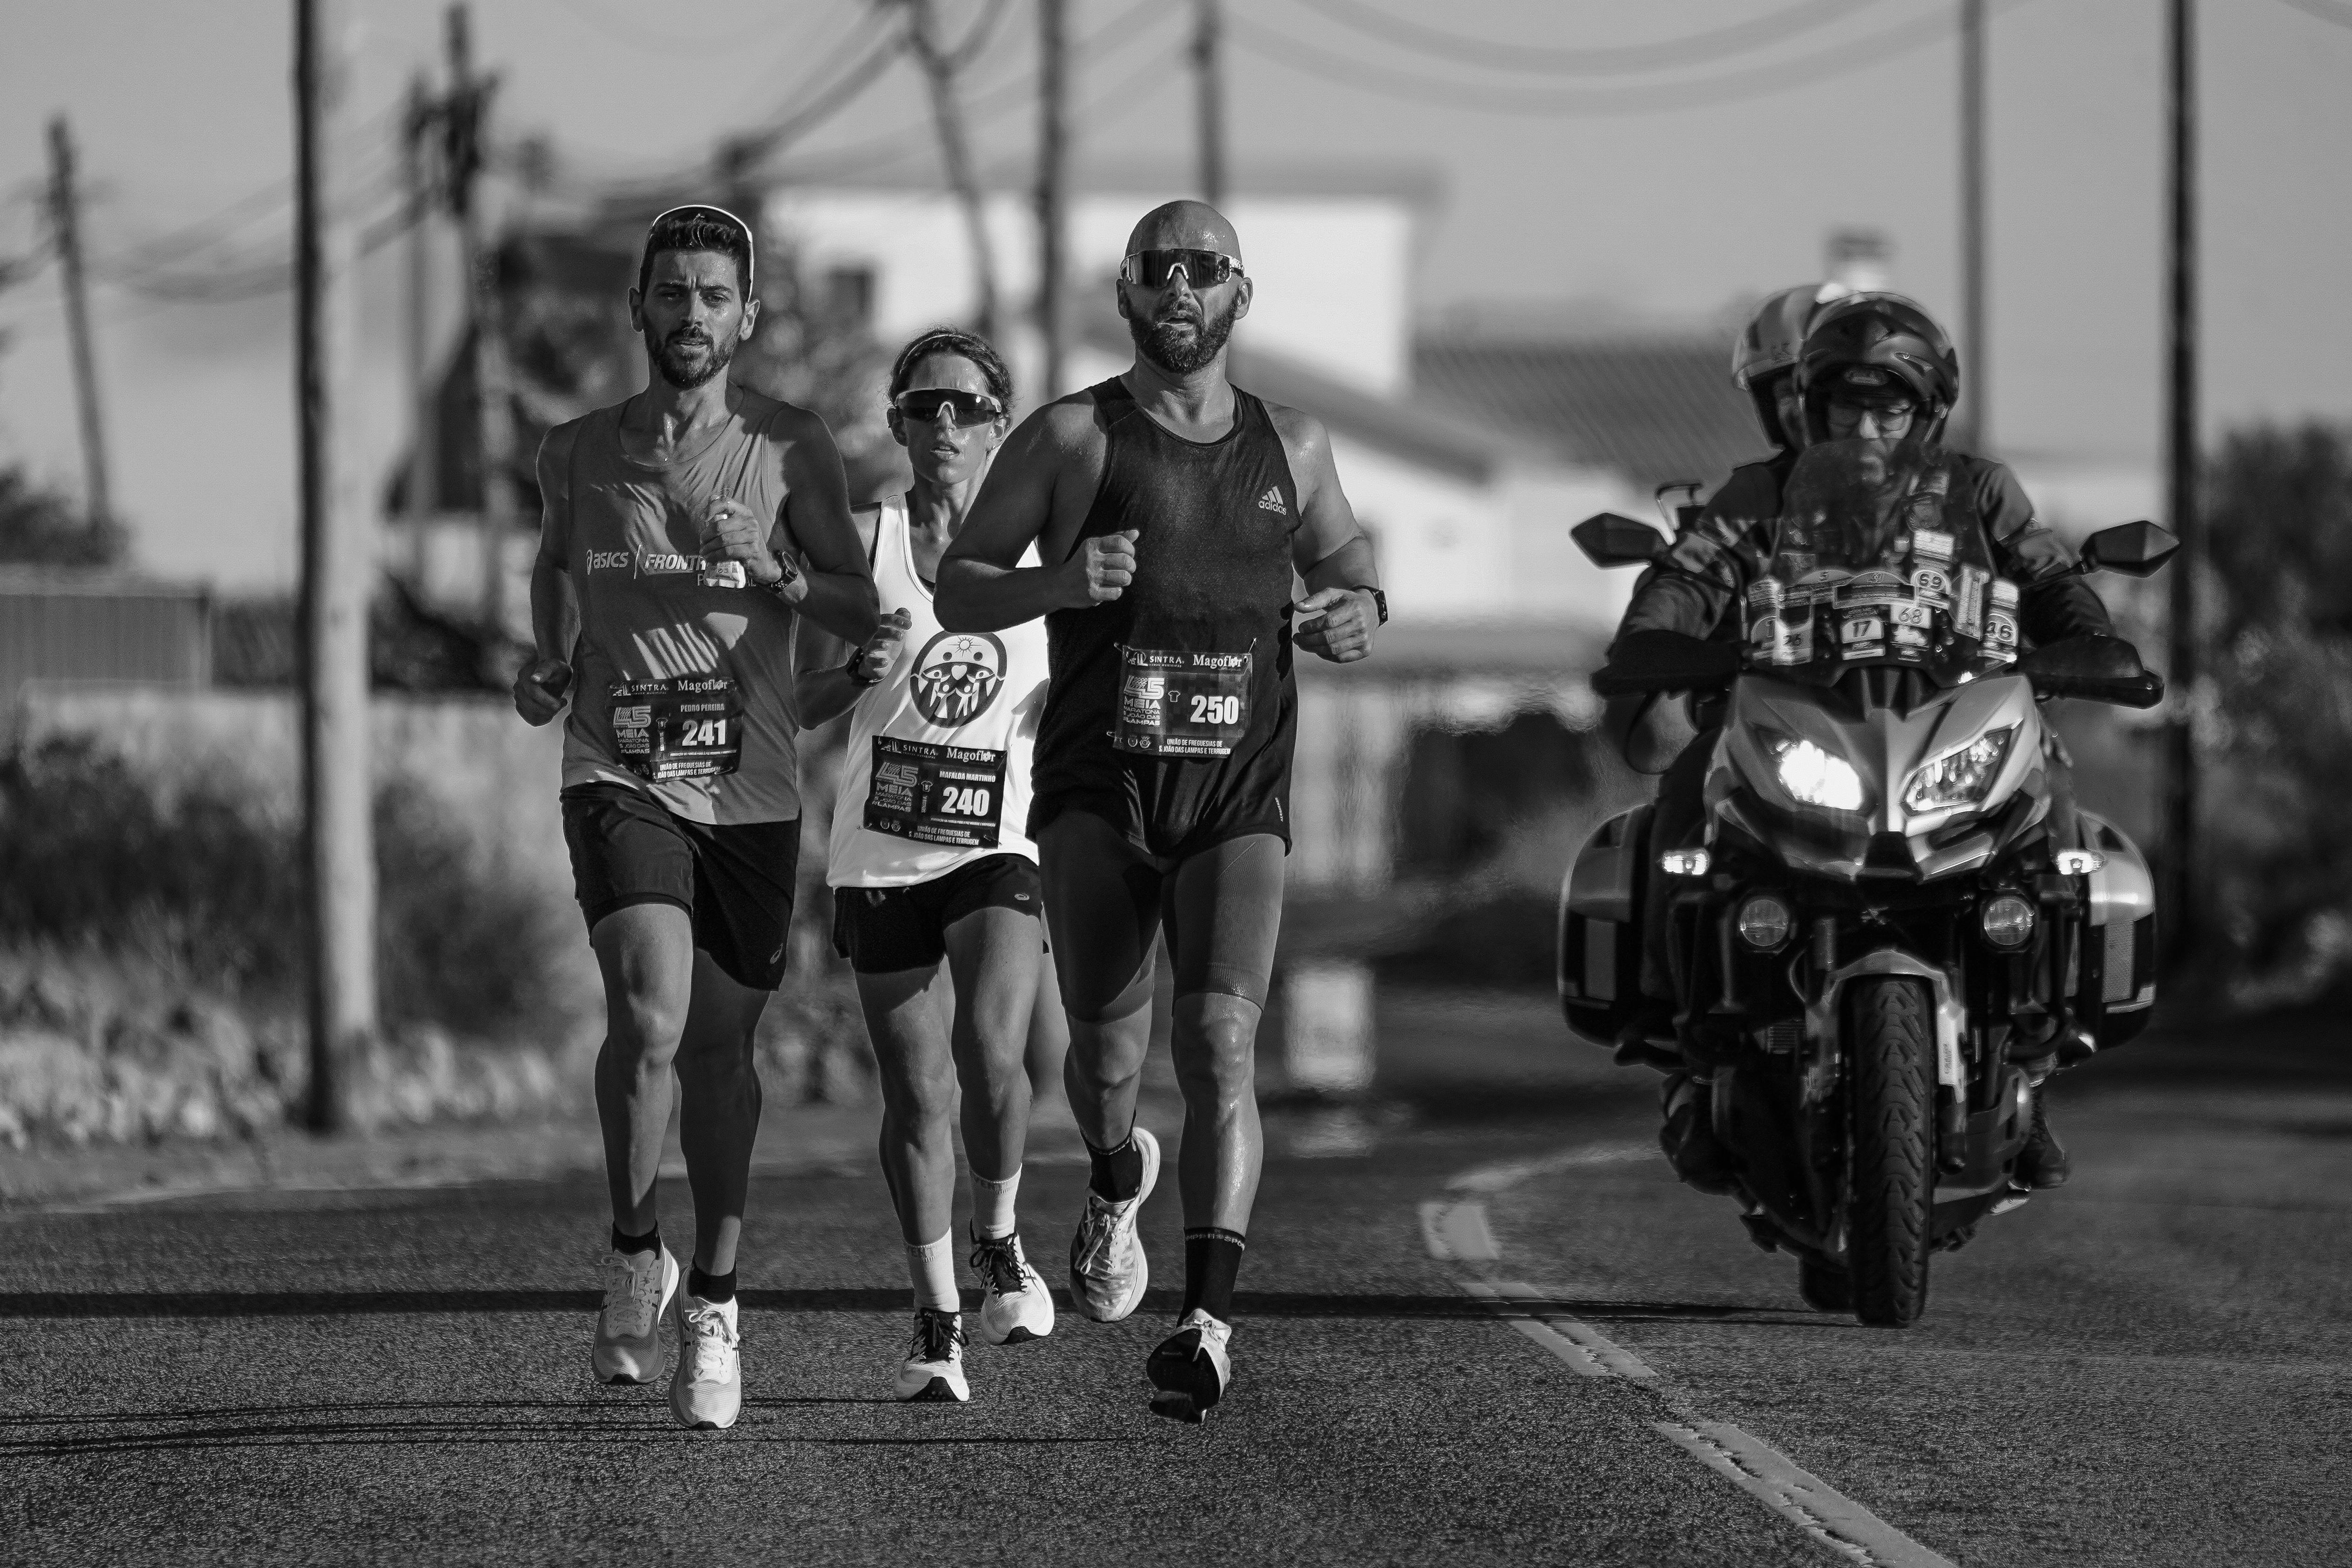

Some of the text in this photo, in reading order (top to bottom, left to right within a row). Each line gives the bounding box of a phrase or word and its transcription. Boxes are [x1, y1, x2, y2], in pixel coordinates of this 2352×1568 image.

[1258, 500, 1287, 515] adidas
[1898, 607, 1922, 625] 68
[1853, 620, 1872, 638] 17
[1124, 696, 1161, 710] MEIA
[1190, 695, 1239, 724] 250
[615, 728, 649, 739] MEIA
[682, 719, 726, 746] 241
[903, 744, 935, 756] SINTRA
[939, 770, 996, 782] MAFALDA MARTINHO
[876, 781, 913, 797] MEIA
[941, 786, 990, 817] 240
[934, 835, 952, 843] LAMPAS
[937, 828, 964, 837] FREGUESIAS
